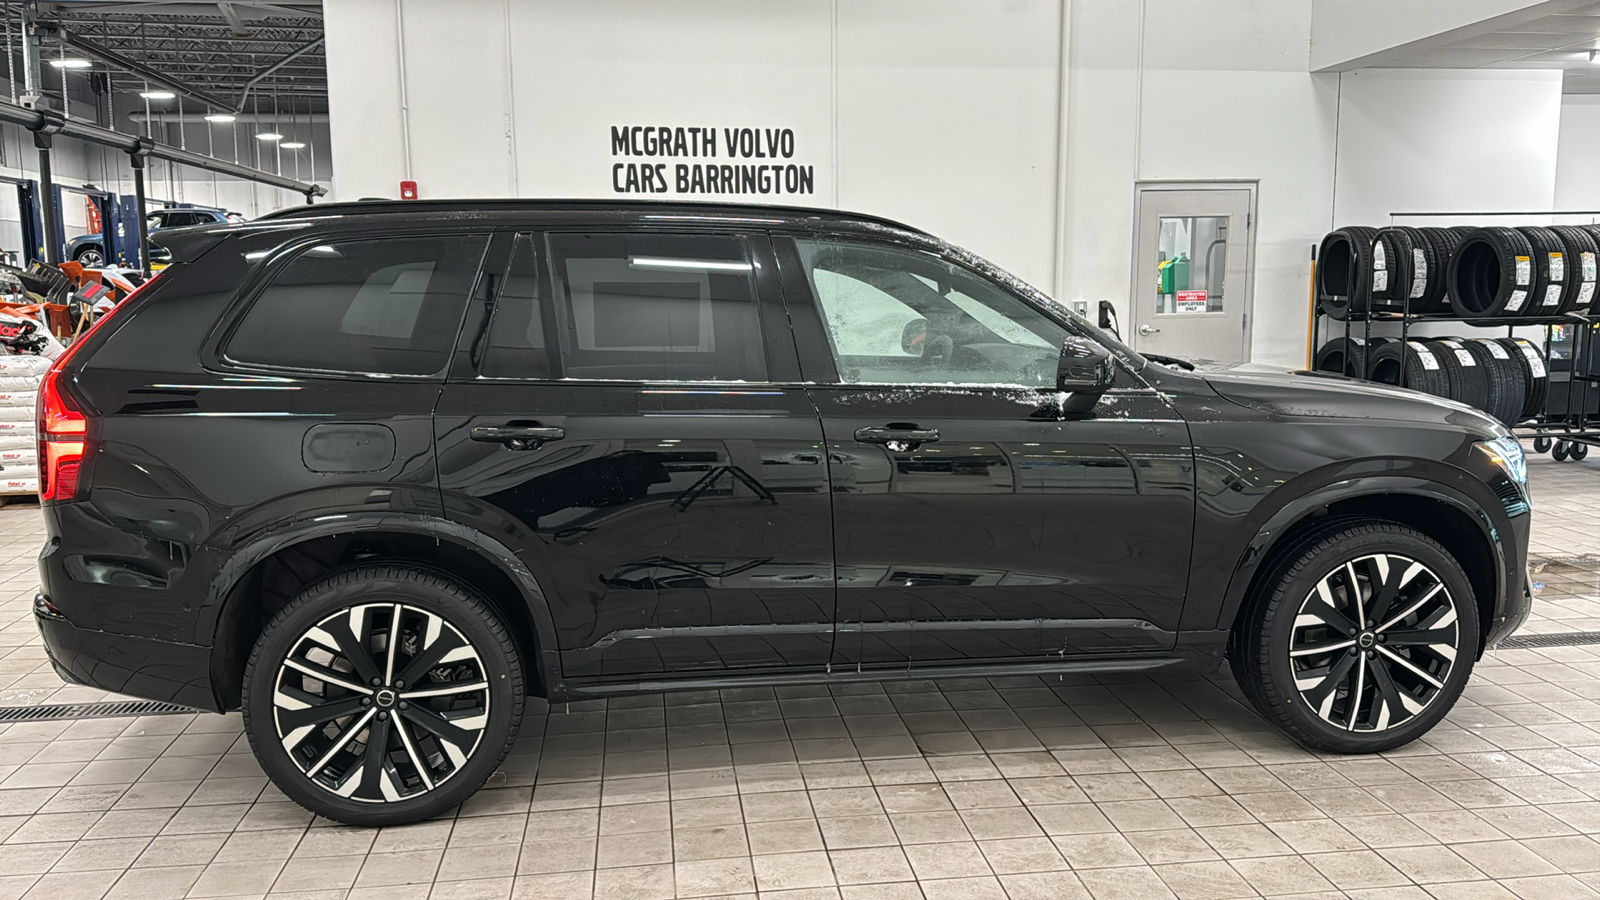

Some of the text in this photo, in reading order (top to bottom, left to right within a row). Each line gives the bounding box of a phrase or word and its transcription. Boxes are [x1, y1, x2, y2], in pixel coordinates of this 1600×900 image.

[611, 126, 795, 158] MCGRATH VOLVO
[612, 163, 814, 194] CARS BARRINGTON
